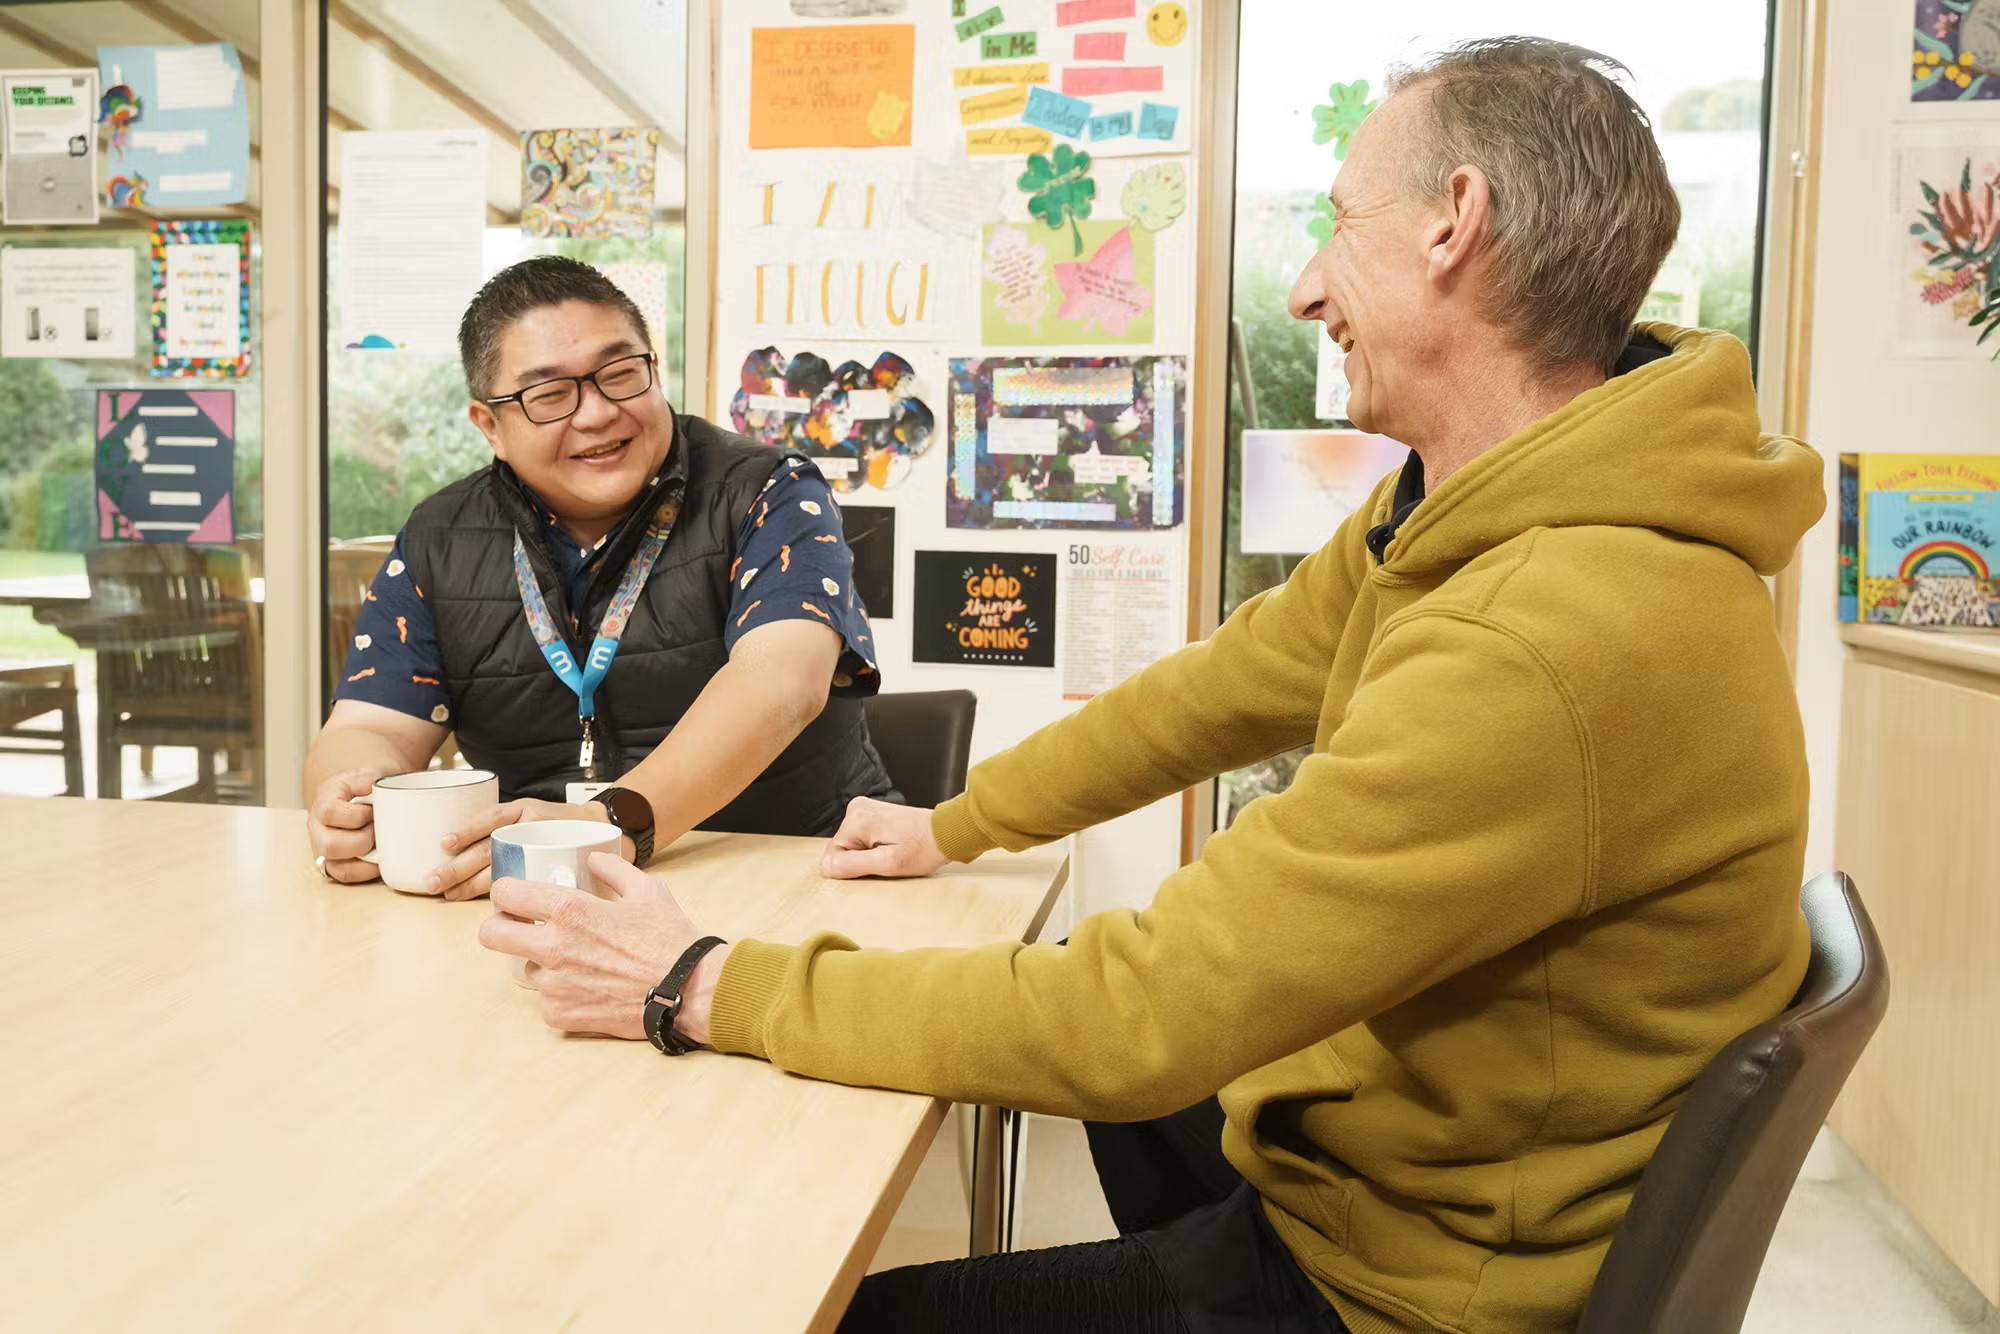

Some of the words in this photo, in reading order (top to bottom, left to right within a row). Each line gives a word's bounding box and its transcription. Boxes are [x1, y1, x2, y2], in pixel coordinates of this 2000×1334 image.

[985, 38, 1002, 58] in
[1009, 34, 1036, 58] Me
[1891, 526, 1921, 550] OUR
[1924, 519, 1996, 550] RAINBOW
[1068, 544, 1090, 565] 50
[966, 575, 1022, 599] GOOD
[960, 598, 1027, 622] things
[978, 614, 1001, 628] ARE
[958, 626, 1029, 649] COMING
